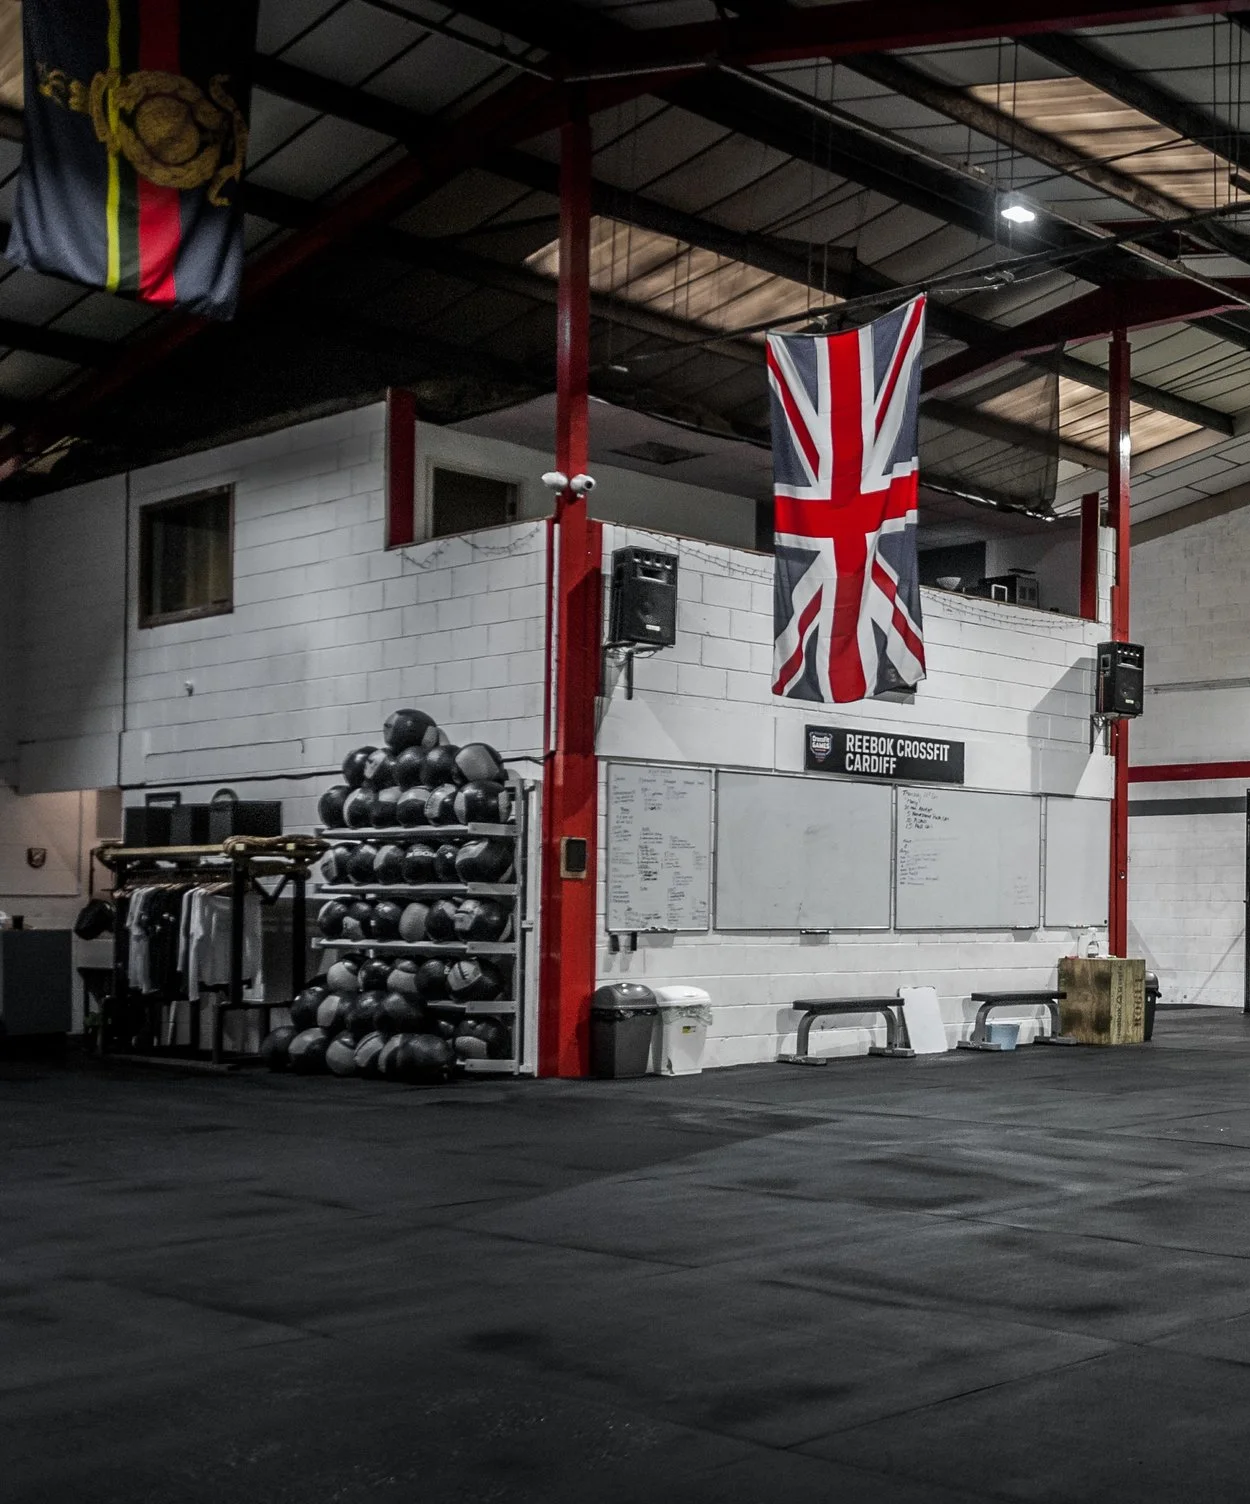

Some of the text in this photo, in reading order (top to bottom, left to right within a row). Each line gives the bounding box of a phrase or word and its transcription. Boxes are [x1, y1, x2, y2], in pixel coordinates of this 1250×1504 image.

[846, 733, 950, 762] REEBOK CROSSFIT
[845, 753, 897, 775] CARDIFF
